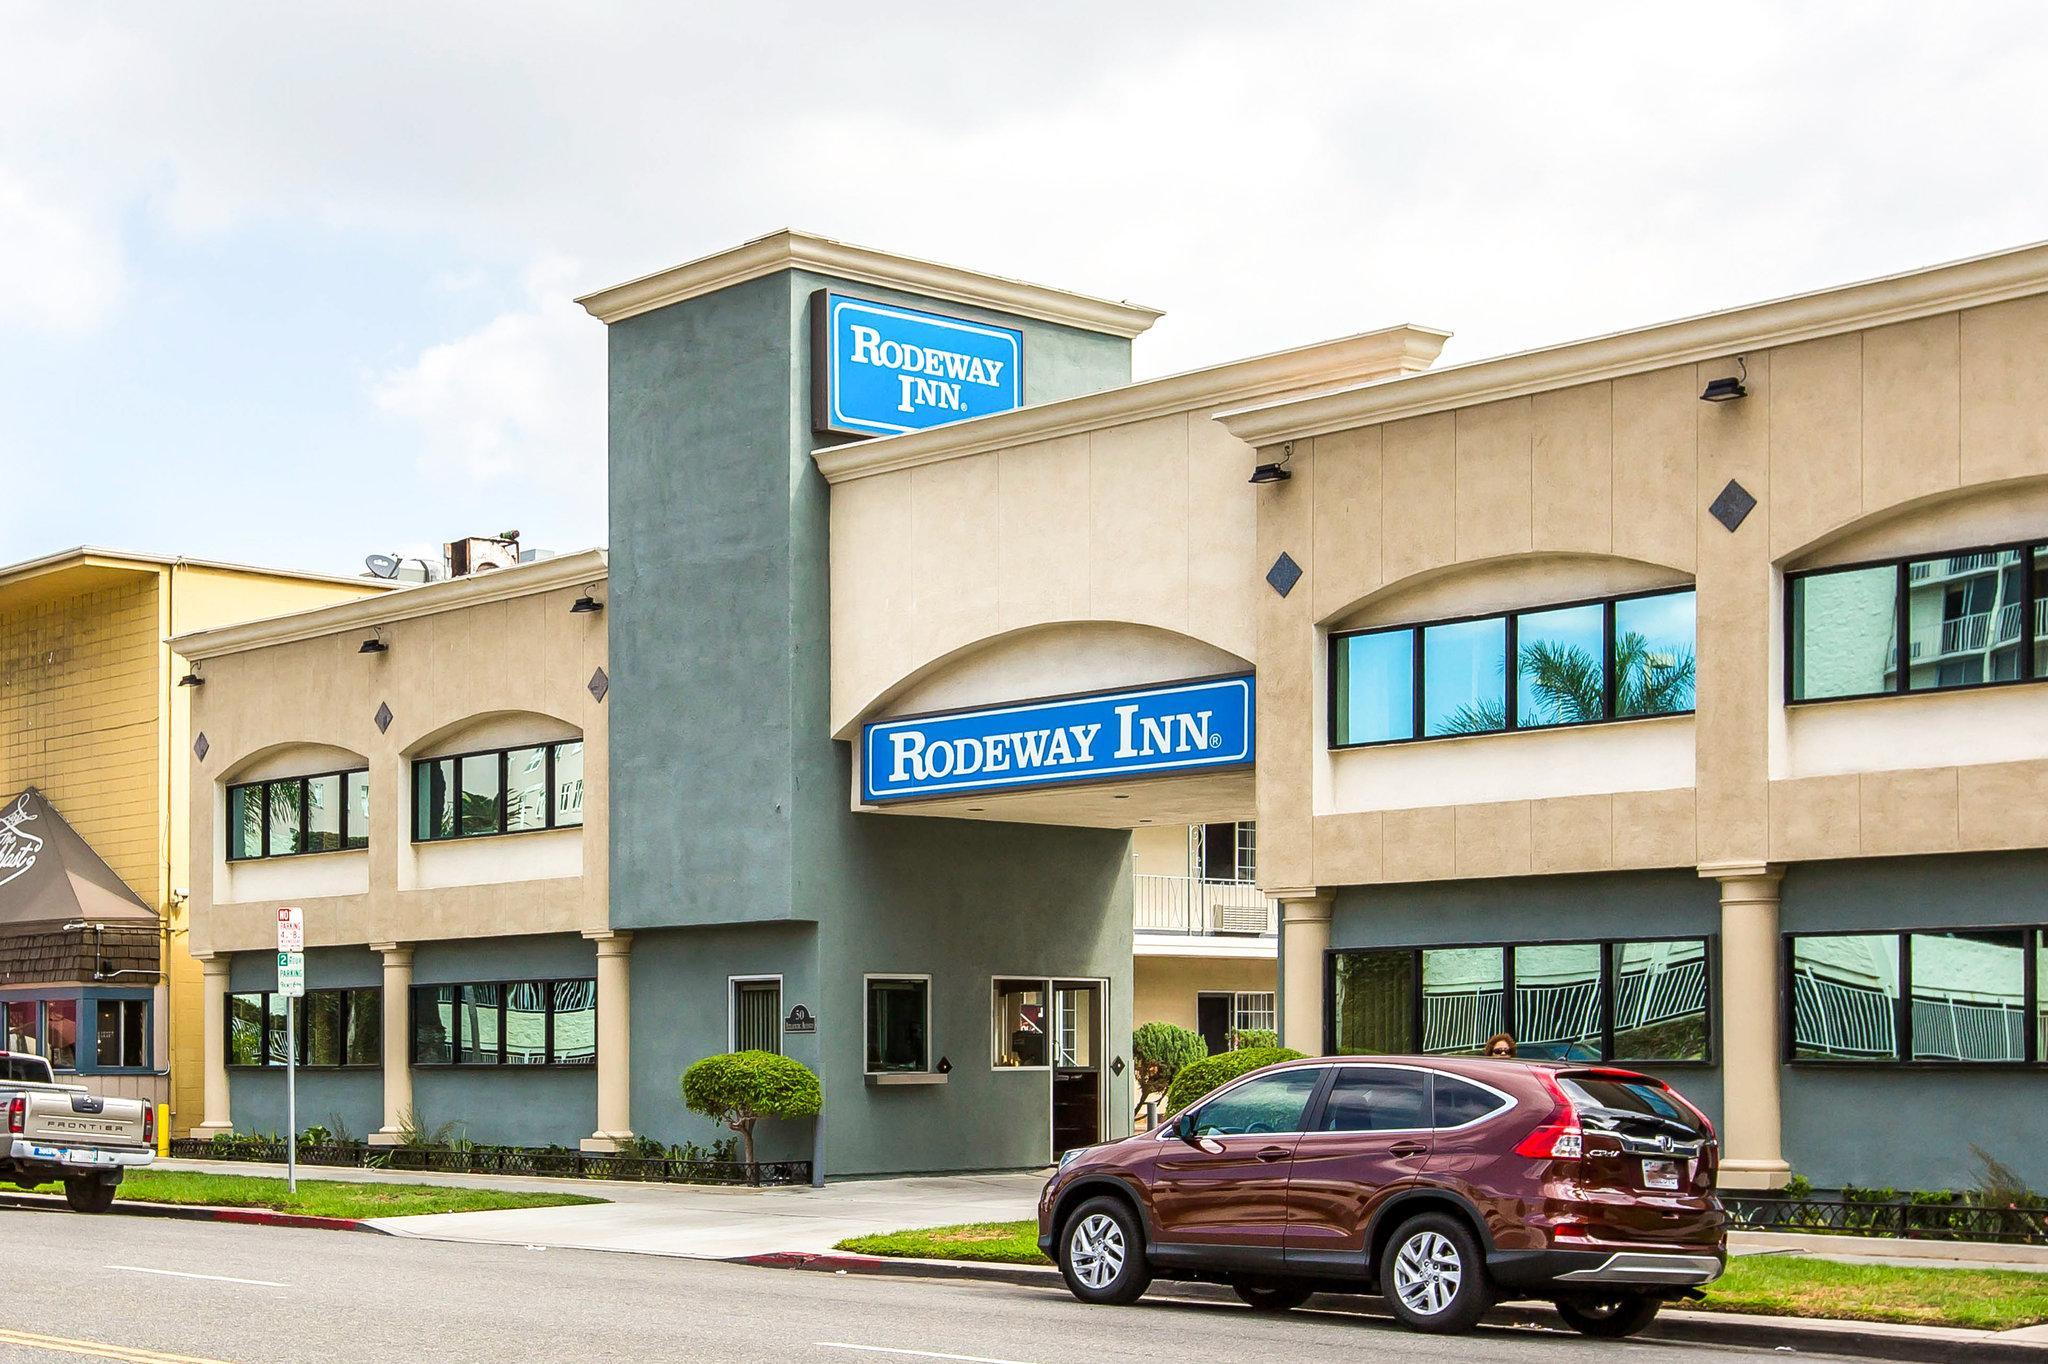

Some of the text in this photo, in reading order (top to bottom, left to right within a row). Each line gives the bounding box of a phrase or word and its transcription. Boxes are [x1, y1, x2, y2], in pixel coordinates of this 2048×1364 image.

[850, 325, 1004, 388] RODEWAY
[888, 723, 1102, 782] RODEWAY
[279, 909, 290, 921] NO
[280, 955, 288, 965] 2
[280, 969, 303, 978] PARKING
[795, 1009, 805, 1020] 50
[47, 1121, 124, 1132] FRONTIER
